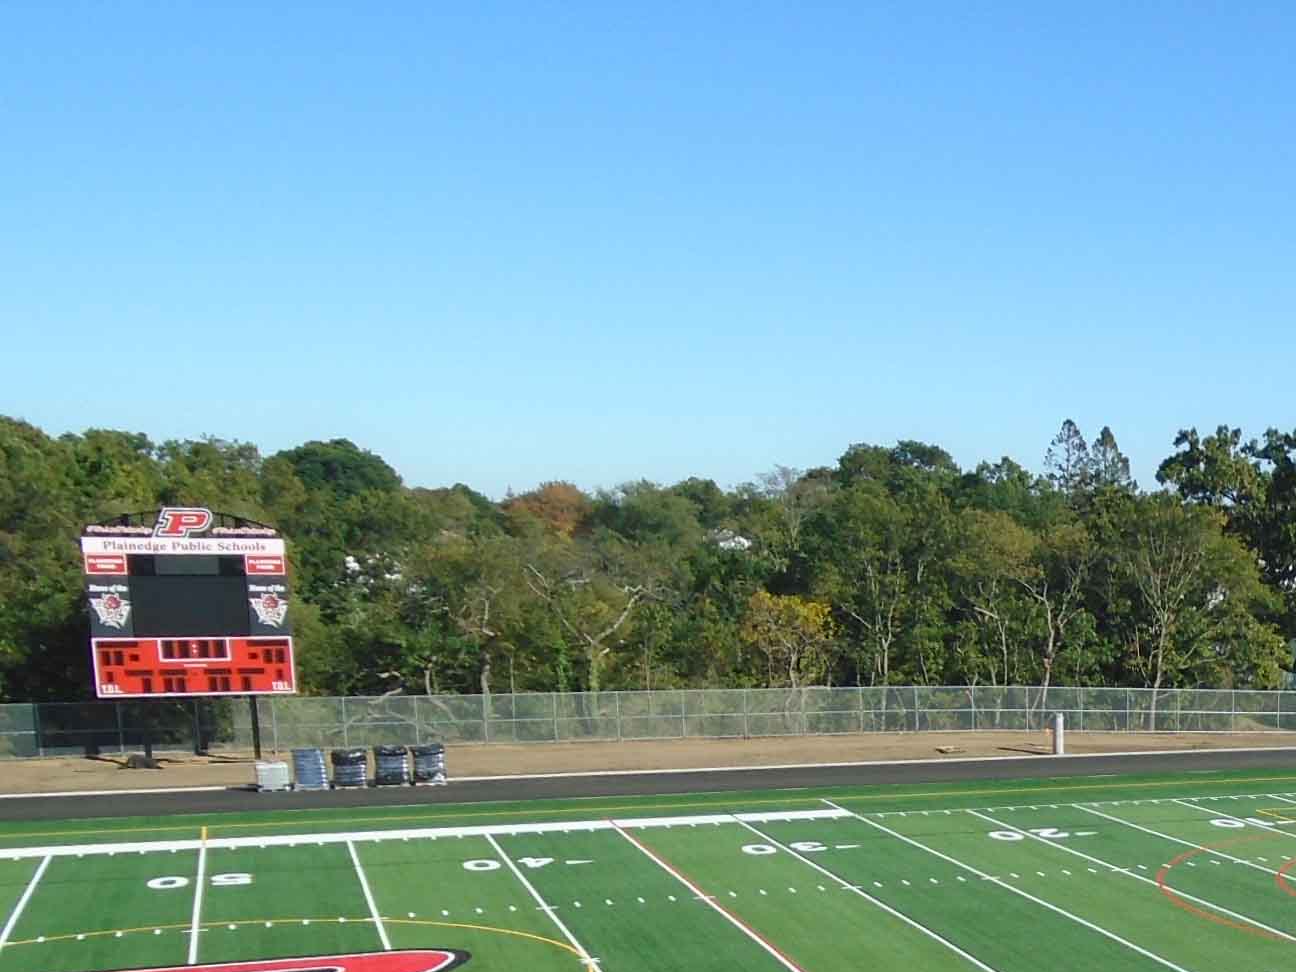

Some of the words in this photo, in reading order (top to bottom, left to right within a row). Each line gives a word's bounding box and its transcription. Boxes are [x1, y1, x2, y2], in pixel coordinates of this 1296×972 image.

[152, 506, 213, 537] P
[103, 541, 168, 553] Plainedge
[172, 541, 212, 552] Public
[217, 542, 267, 552] Schools
